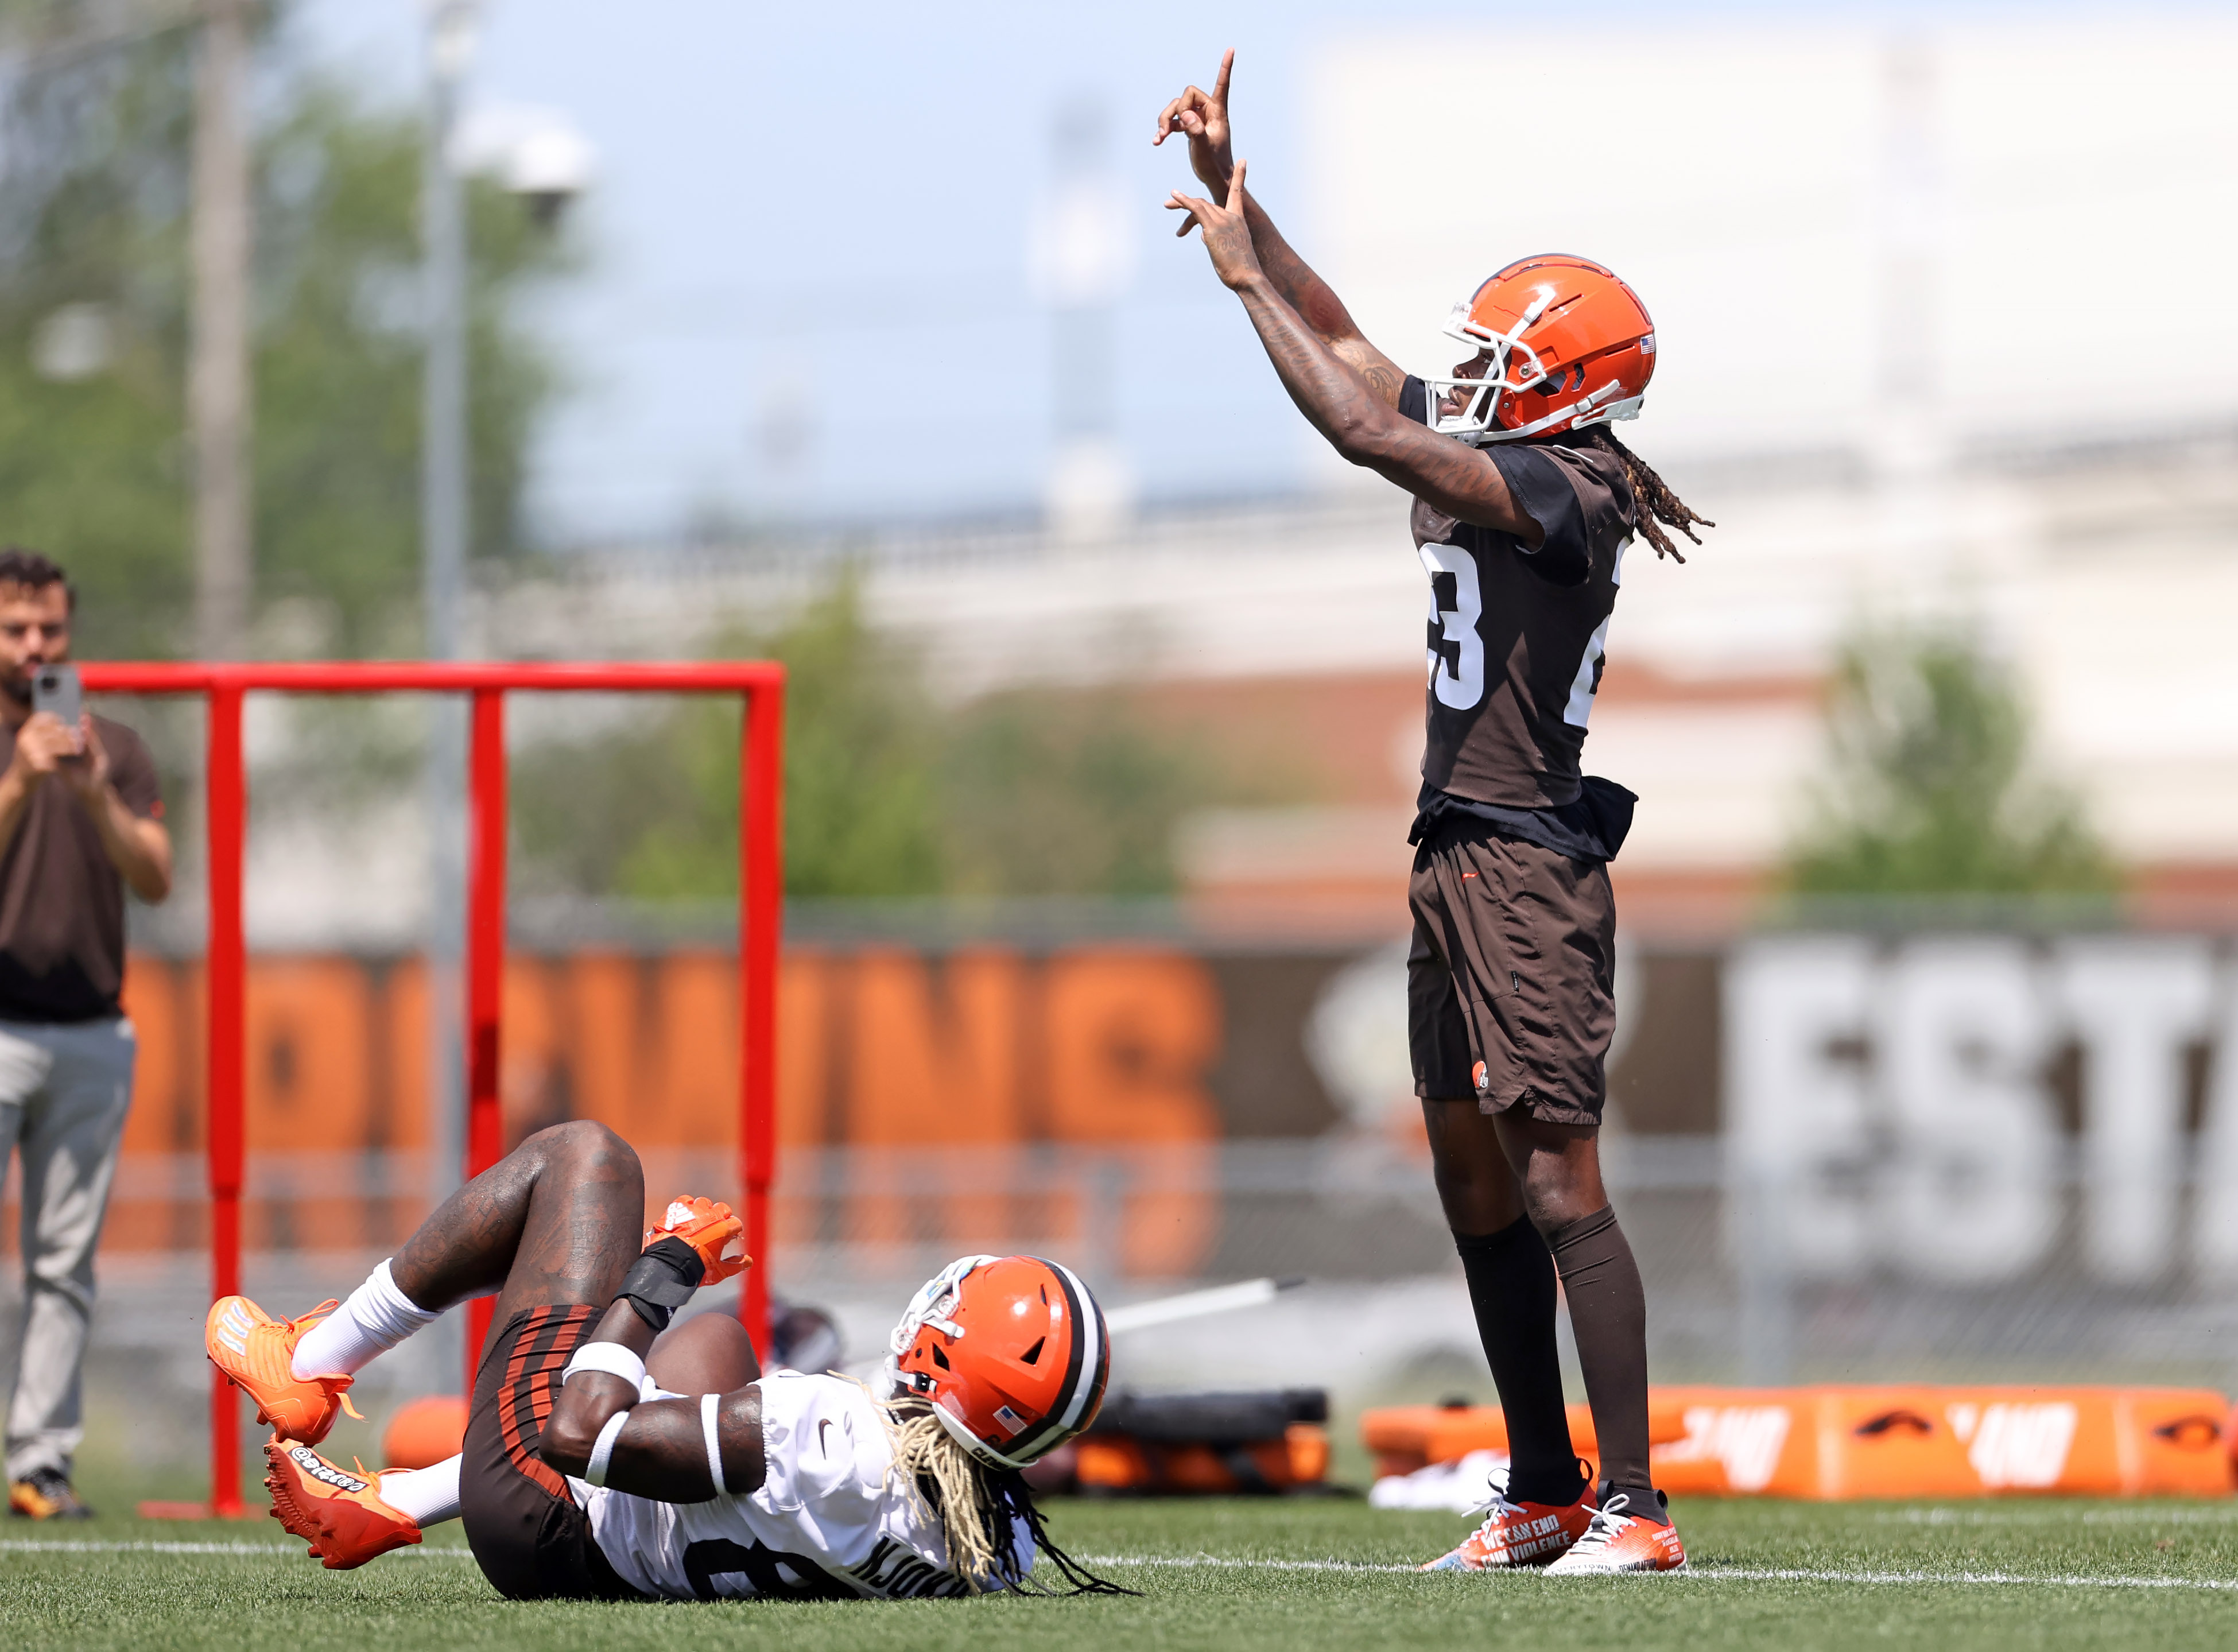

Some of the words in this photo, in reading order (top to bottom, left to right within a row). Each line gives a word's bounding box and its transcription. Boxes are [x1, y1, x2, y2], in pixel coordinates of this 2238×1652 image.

[1480, 1530, 1505, 1550] WE
[1504, 1522, 1532, 1544] CAN
[1531, 1514, 1560, 1537] END
[1509, 1530, 1572, 1562] VIOLENCE
